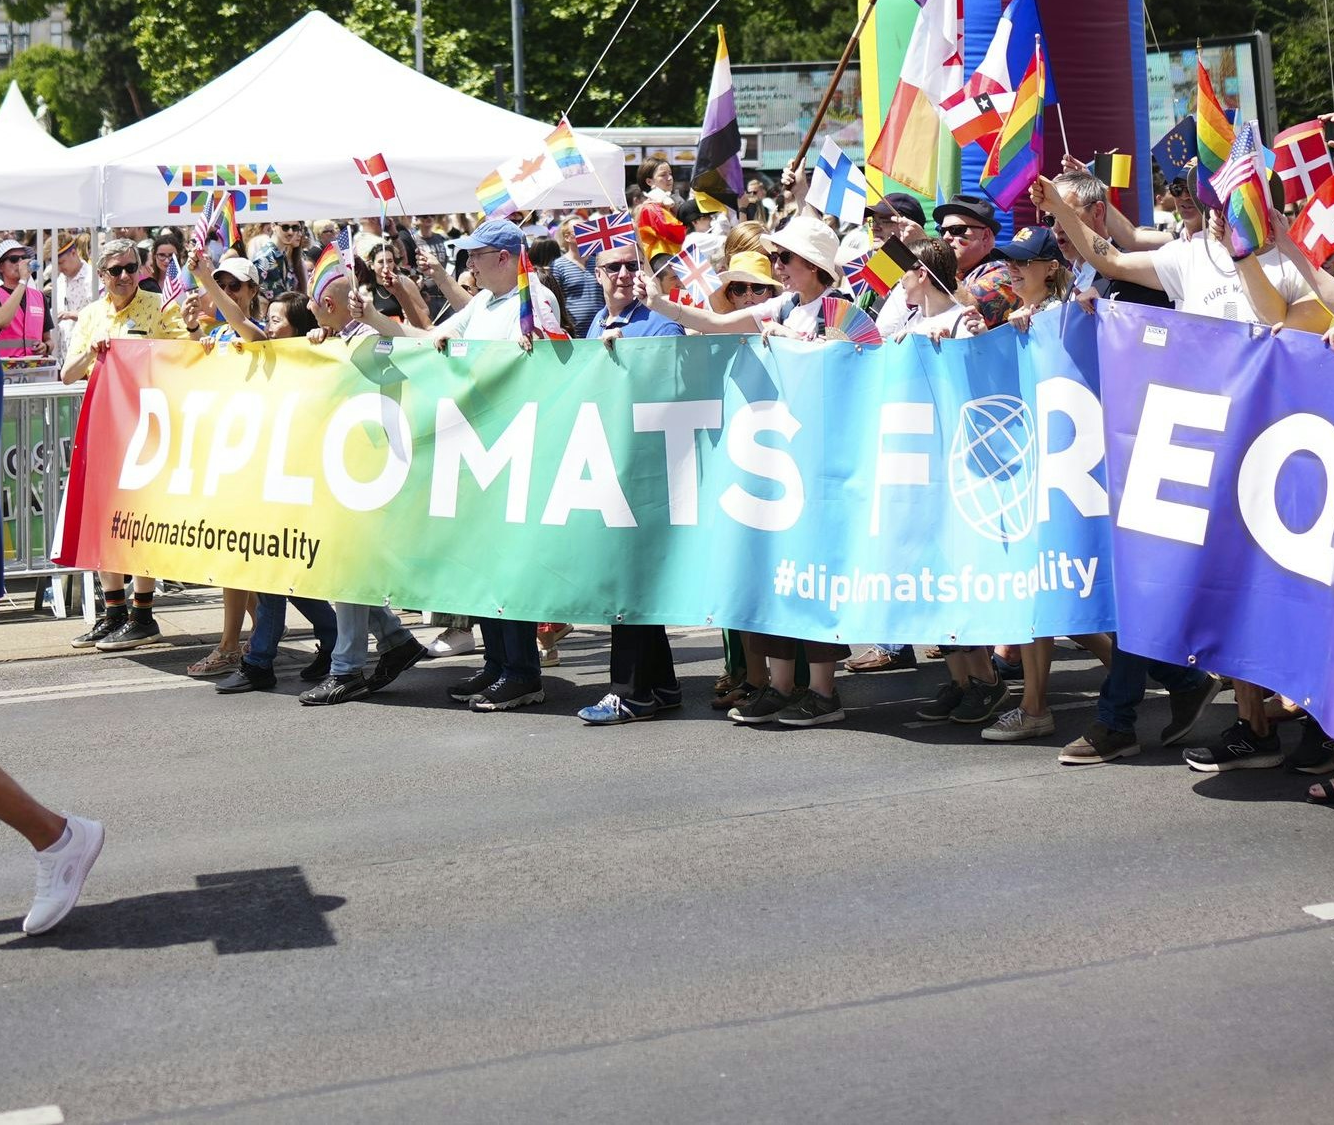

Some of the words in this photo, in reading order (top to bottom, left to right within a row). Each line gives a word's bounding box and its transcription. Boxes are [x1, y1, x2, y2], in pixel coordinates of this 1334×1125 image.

[156, 164, 283, 187] VIENNA
[168, 189, 268, 214] PRIDE
[1203, 285, 1228, 305] PURE
[118, 388, 805, 532] DIPLOMATS
[869, 377, 1109, 543] FOR
[111, 510, 320, 569] #diplomatsforequality
